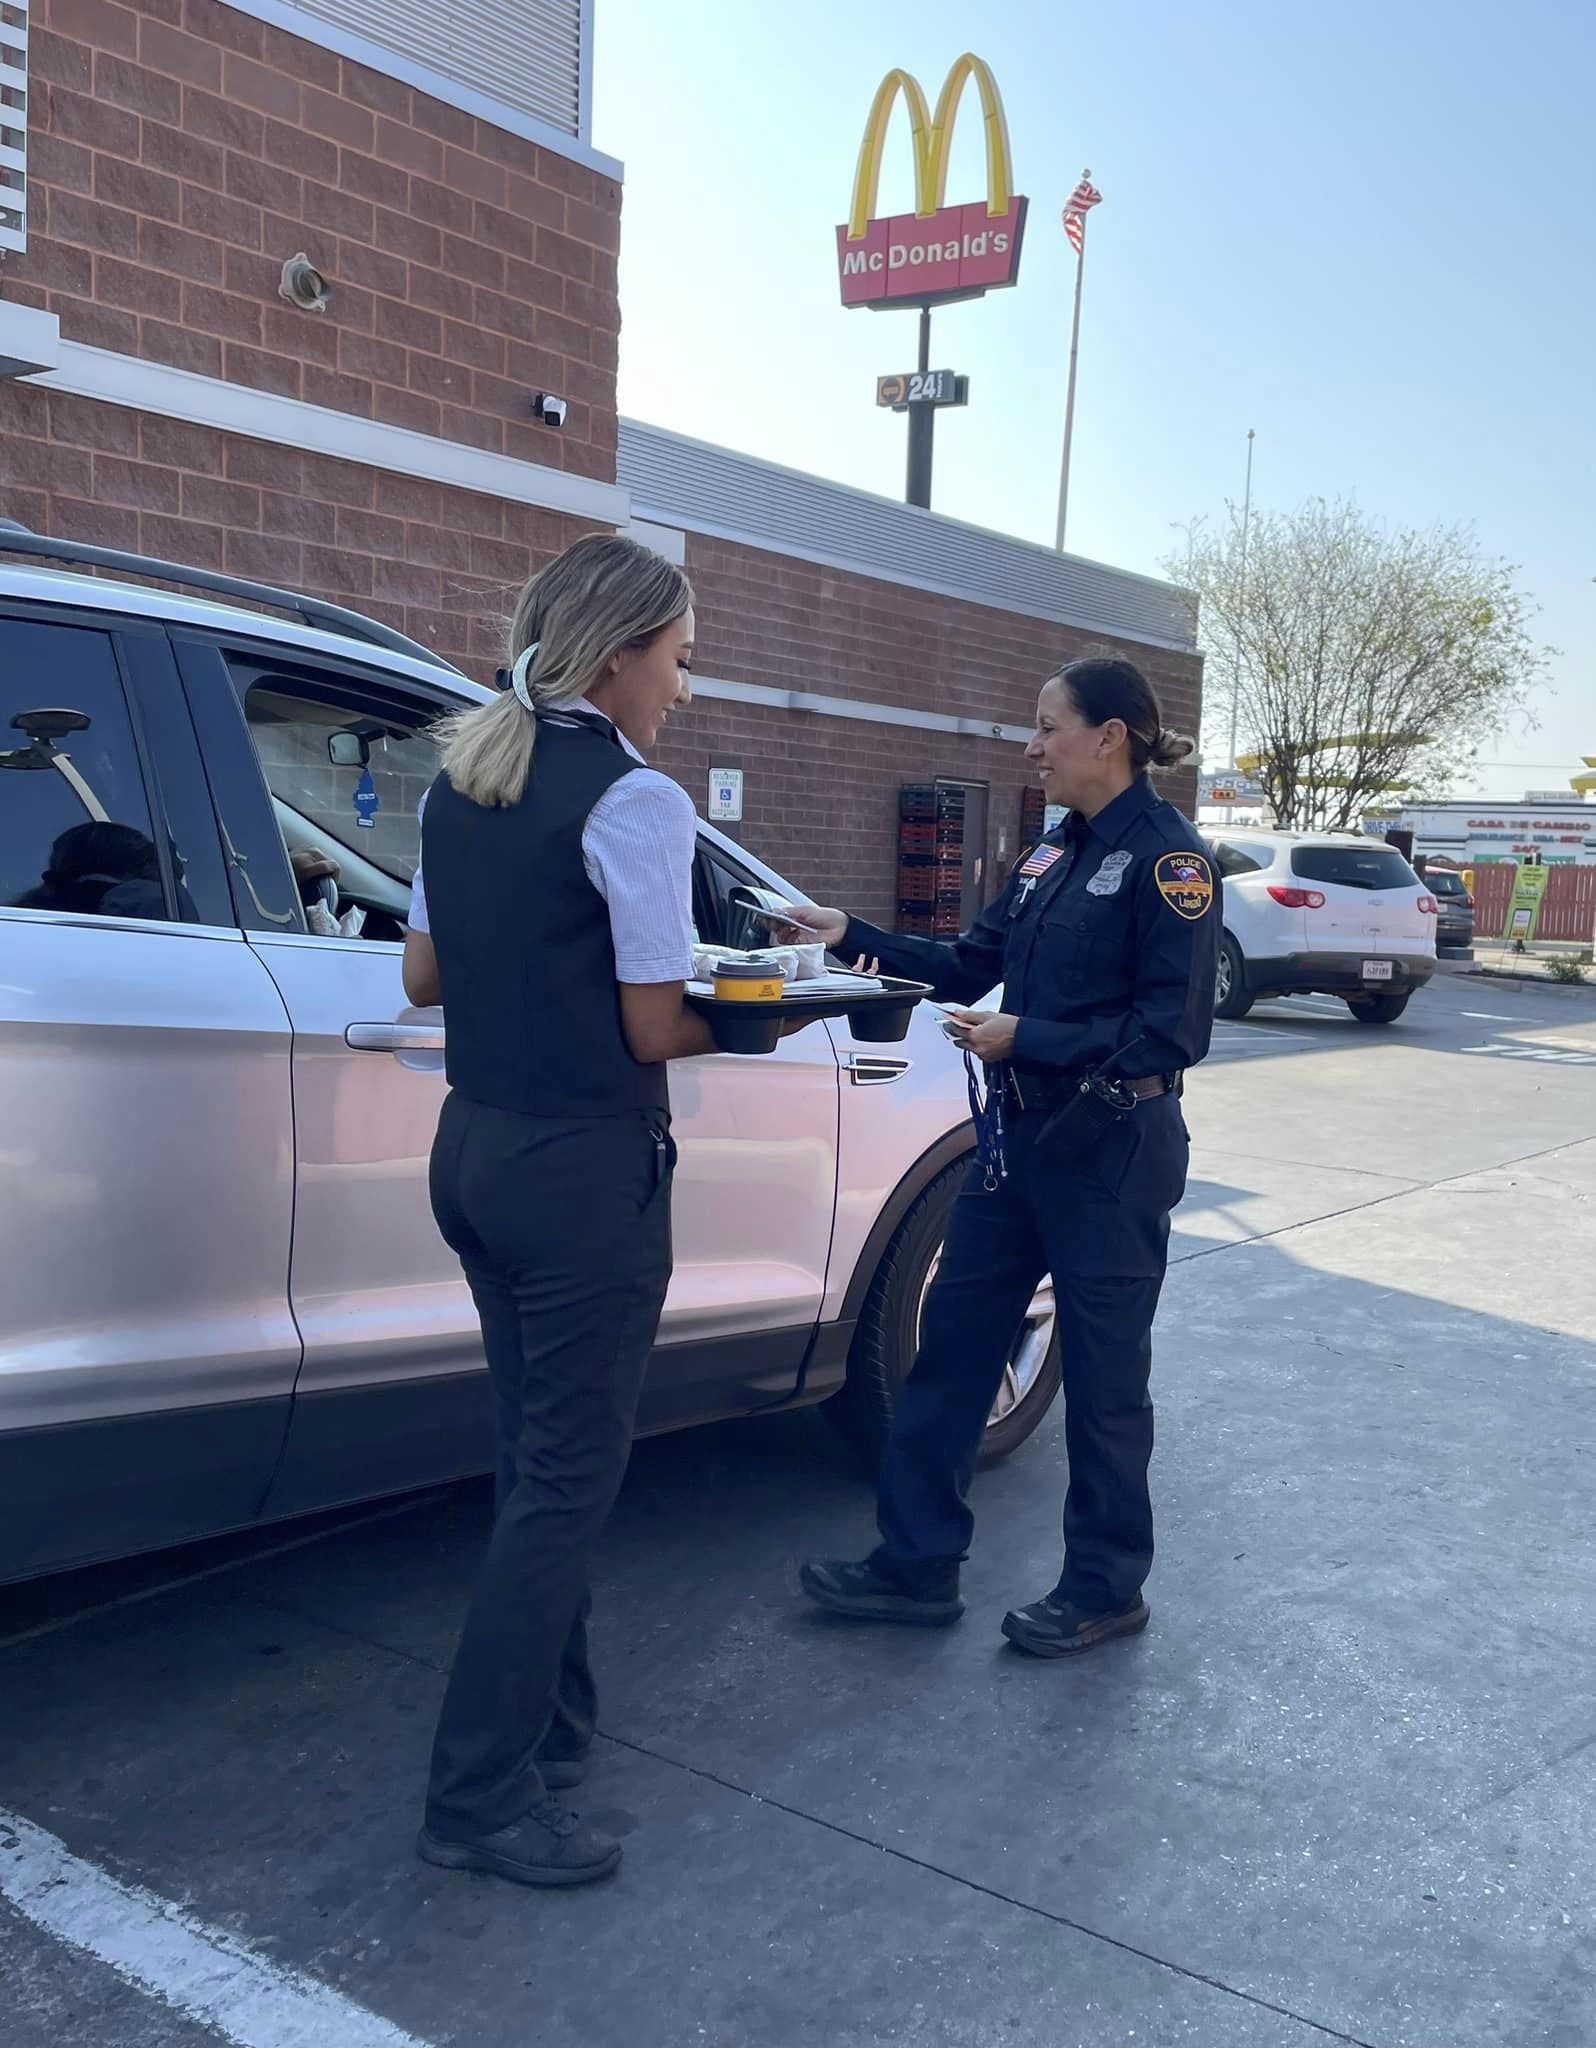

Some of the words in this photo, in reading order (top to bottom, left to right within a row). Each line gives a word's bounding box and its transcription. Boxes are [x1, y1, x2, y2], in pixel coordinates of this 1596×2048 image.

[843, 230, 1009, 275] McDonald's
[1467, 819, 1505, 829] CASA
[1532, 820, 1592, 832] CAMBIO
[1170, 858, 1201, 870] POLICE
